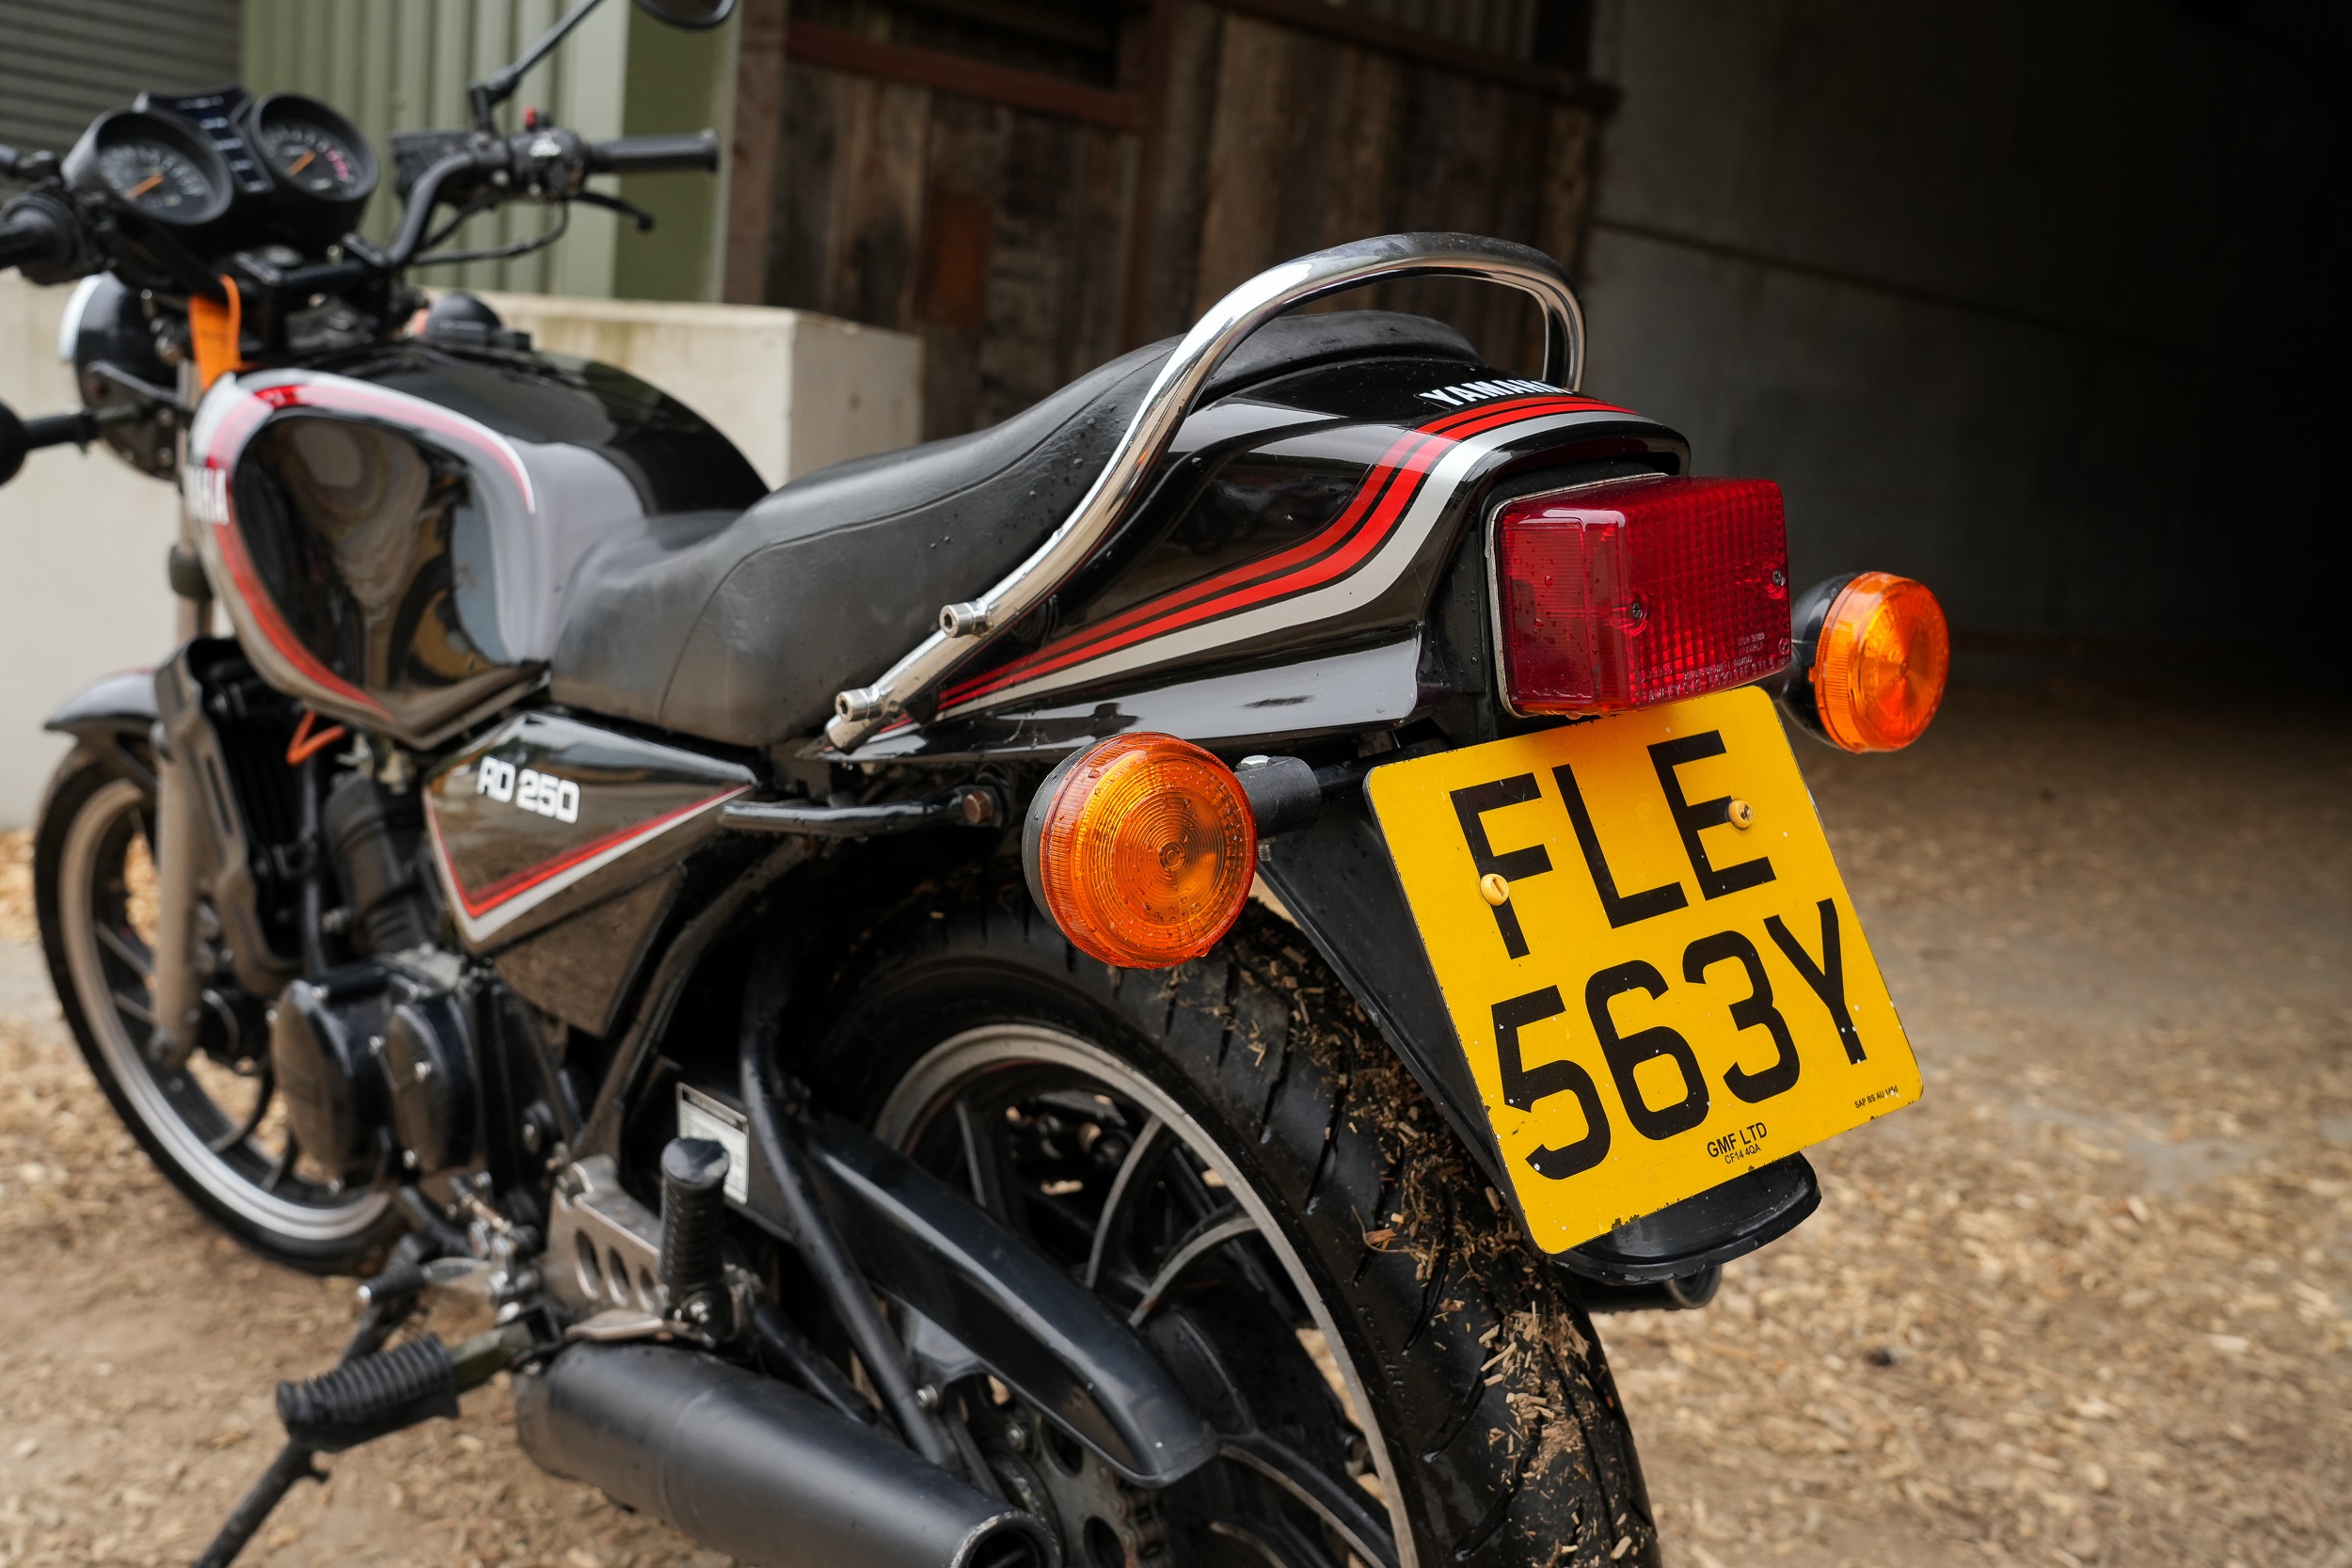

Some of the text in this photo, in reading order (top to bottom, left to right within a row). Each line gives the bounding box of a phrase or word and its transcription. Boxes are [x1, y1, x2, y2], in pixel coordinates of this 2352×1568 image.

[476, 755, 580, 824] RD 250
[1449, 730, 1776, 959] FLE
[1491, 898, 1867, 1180] 563Y
[1854, 1098, 1867, 1108] SAP
[1867, 1094, 1876, 1103] BS
[1876, 1090, 1885, 1100] AU
[1707, 1121, 1768, 1158] GMF LTD
[1724, 1143, 1762, 1164] CF14 4QA
